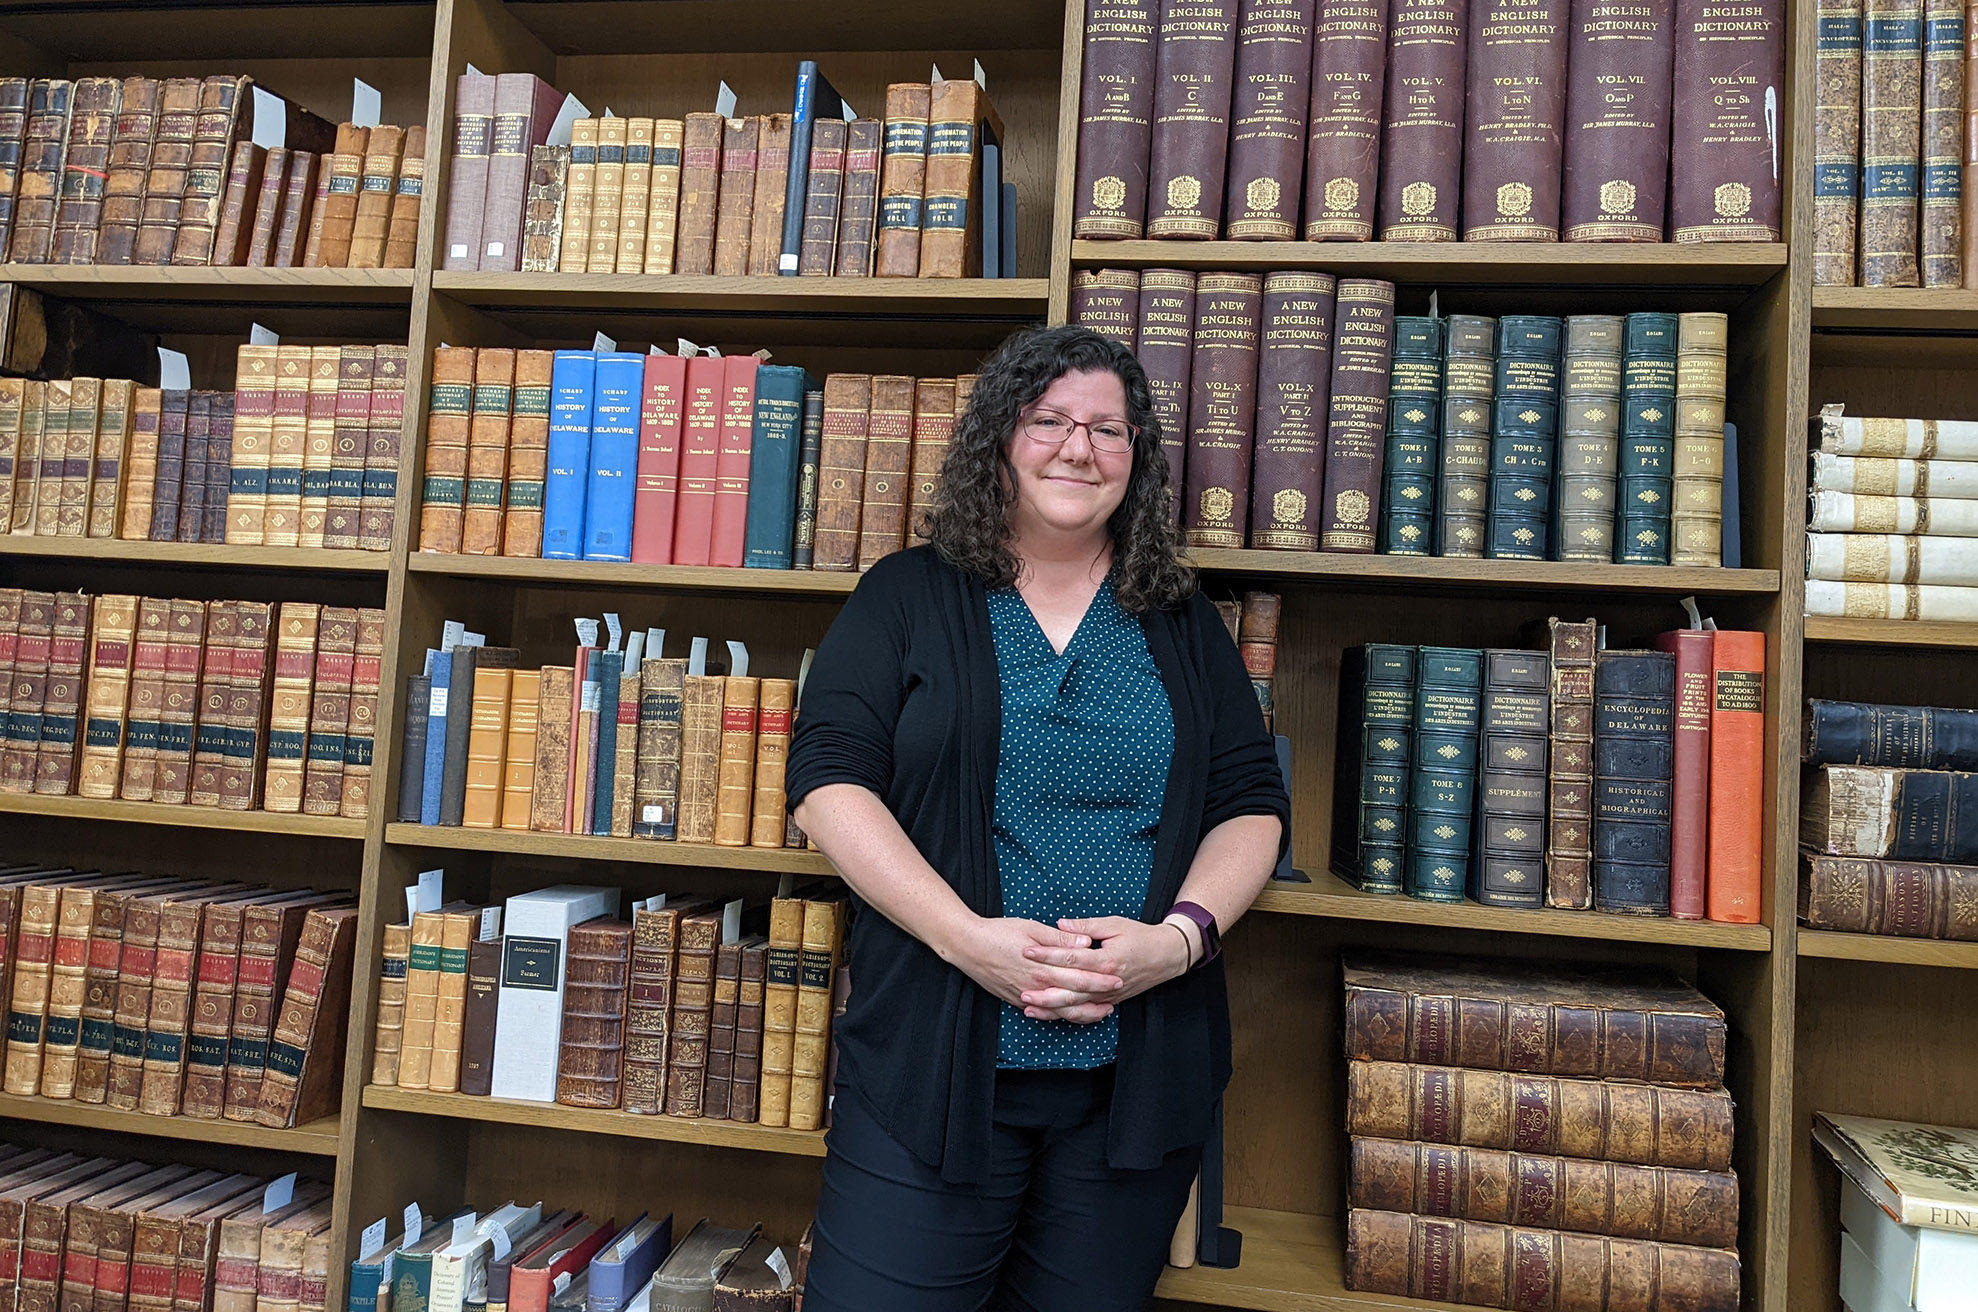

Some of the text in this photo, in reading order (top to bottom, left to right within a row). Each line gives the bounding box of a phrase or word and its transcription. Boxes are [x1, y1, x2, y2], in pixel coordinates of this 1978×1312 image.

[1094, 10, 1147, 19] ENGLISH
[1168, 8, 1223, 18] ENGLISH
[1248, 10, 1301, 21] ENGLISH
[1324, 8, 1378, 18] ENGLISH
[1490, 11, 1548, 21] ENGLISH
[1592, 6, 1650, 17] ENGLISH
[1703, 8, 1762, 17] ENGLISH
[1398, 12, 1454, 22] ENGLISH
[1087, 24, 1154, 34] DICTIONARY
[1162, 22, 1230, 33] DICTIONARY
[1240, 24, 1308, 36] DICTIONARY
[1317, 22, 1384, 34] DICTIONARY
[1390, 26, 1460, 37] DICTIONARY
[1482, 26, 1556, 36] DICTIONARY
[1584, 22, 1659, 32] DICTIONARY
[1694, 22, 1772, 32] DICTIONARY
[1099, 75, 1126, 83] VOL.
[1325, 73, 1372, 82] VOL. IV.
[1436, 78, 1445, 86] V.
[1596, 76, 1627, 84] VOL.
[1188, 92, 1196, 100] C
[1409, 96, 1417, 104] H
[1429, 96, 1436, 104] K
[1504, 96, 1511, 104] L
[1523, 96, 1531, 104] N
[1714, 96, 1723, 105] Q
[1598, 214, 1638, 222] OXFORD
[1088, 298, 1123, 306] A NEW
[1161, 299, 1184, 308] NEW
[1210, 302, 1246, 310] A NEW
[1281, 302, 1318, 310] A NEW
[1080, 312, 1129, 321] ENGLISH
[1350, 308, 1383, 317] A NEW
[1147, 313, 1187, 322] ENGLISH
[1201, 316, 1252, 326] ENGLISH
[1273, 316, 1324, 325] ENGLISH
[1345, 322, 1385, 333] ENGLISH
[1143, 327, 1189, 338] DICTIONARY
[1195, 330, 1256, 340] DICTIONARY
[1266, 330, 1329, 341] DICTIONARY
[1340, 337, 1387, 347] DICTIONARY
[1332, 396, 1385, 404] INTRODUCTION
[1231, 406, 1239, 415] U
[1280, 406, 1289, 415] V
[1304, 406, 1312, 416] Z
[1334, 404, 1383, 414] SUPPLEMENT
[550, 425, 588, 433] DELAWARE
[1331, 421, 1383, 430] BIBLIOGRAPHY
[1585, 456, 1603, 464] D-E
[1641, 458, 1659, 466] F-K
[1333, 523, 1370, 531] OXFORD
[1428, 696, 1474, 704] DICTIONNAIRE
[1494, 697, 1540, 705] DICTIONNAIRE
[1604, 705, 1669, 715] ENCYCLOPEDIA
[1608, 722, 1668, 731] DELAWARE
[1373, 775, 1394, 783] TOME
[1432, 780, 1454, 788] TOME
[1379, 786, 1395, 795] P-R
[1608, 787, 1664, 797] HISTORICAL
[1438, 793, 1455, 801] S-Z
[1601, 805, 1668, 816] BIOGRAPHICAL
